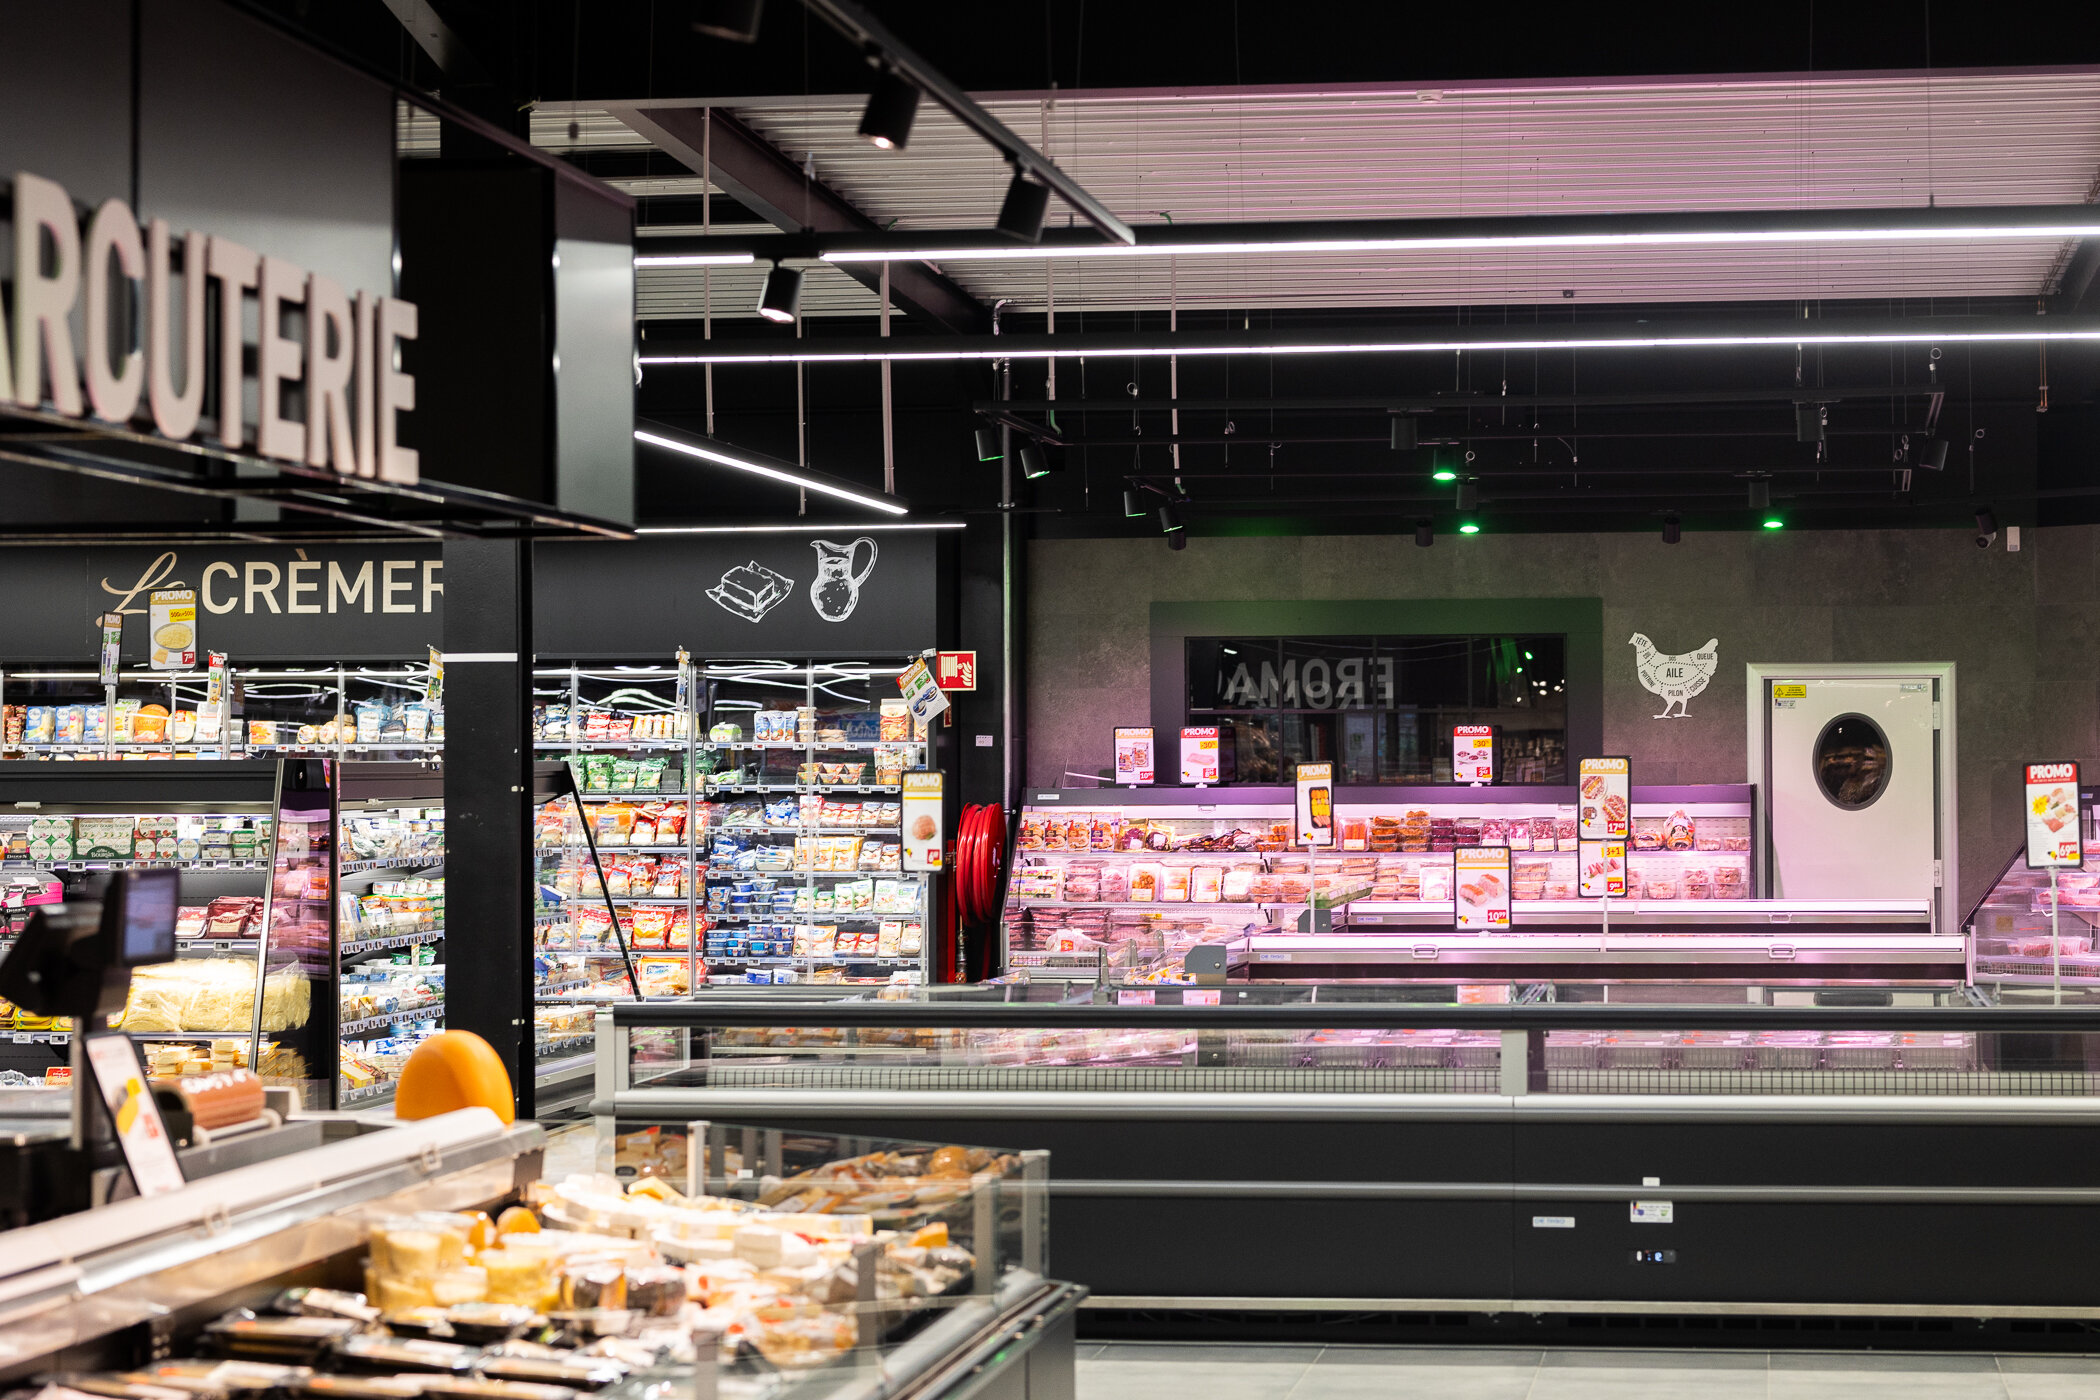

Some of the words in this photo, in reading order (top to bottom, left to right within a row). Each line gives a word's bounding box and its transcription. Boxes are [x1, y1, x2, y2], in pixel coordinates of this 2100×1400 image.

[0, 171, 420, 486] RCUTERIE
[96, 551, 186, 629] L
[154, 590, 193, 600] PROMO
[1665, 667, 1684, 678] AILE
[1667, 689, 1684, 697] PILON
[1184, 727, 1216, 736] PROMO
[1457, 725, 1489, 734] PROMO
[1585, 758, 1625, 770] PROMO
[1301, 764, 1330, 777] PROMO
[2030, 763, 2073, 779] PROMO
[907, 774, 940, 788] PROMO
[1461, 847, 1505, 859] PROMO
